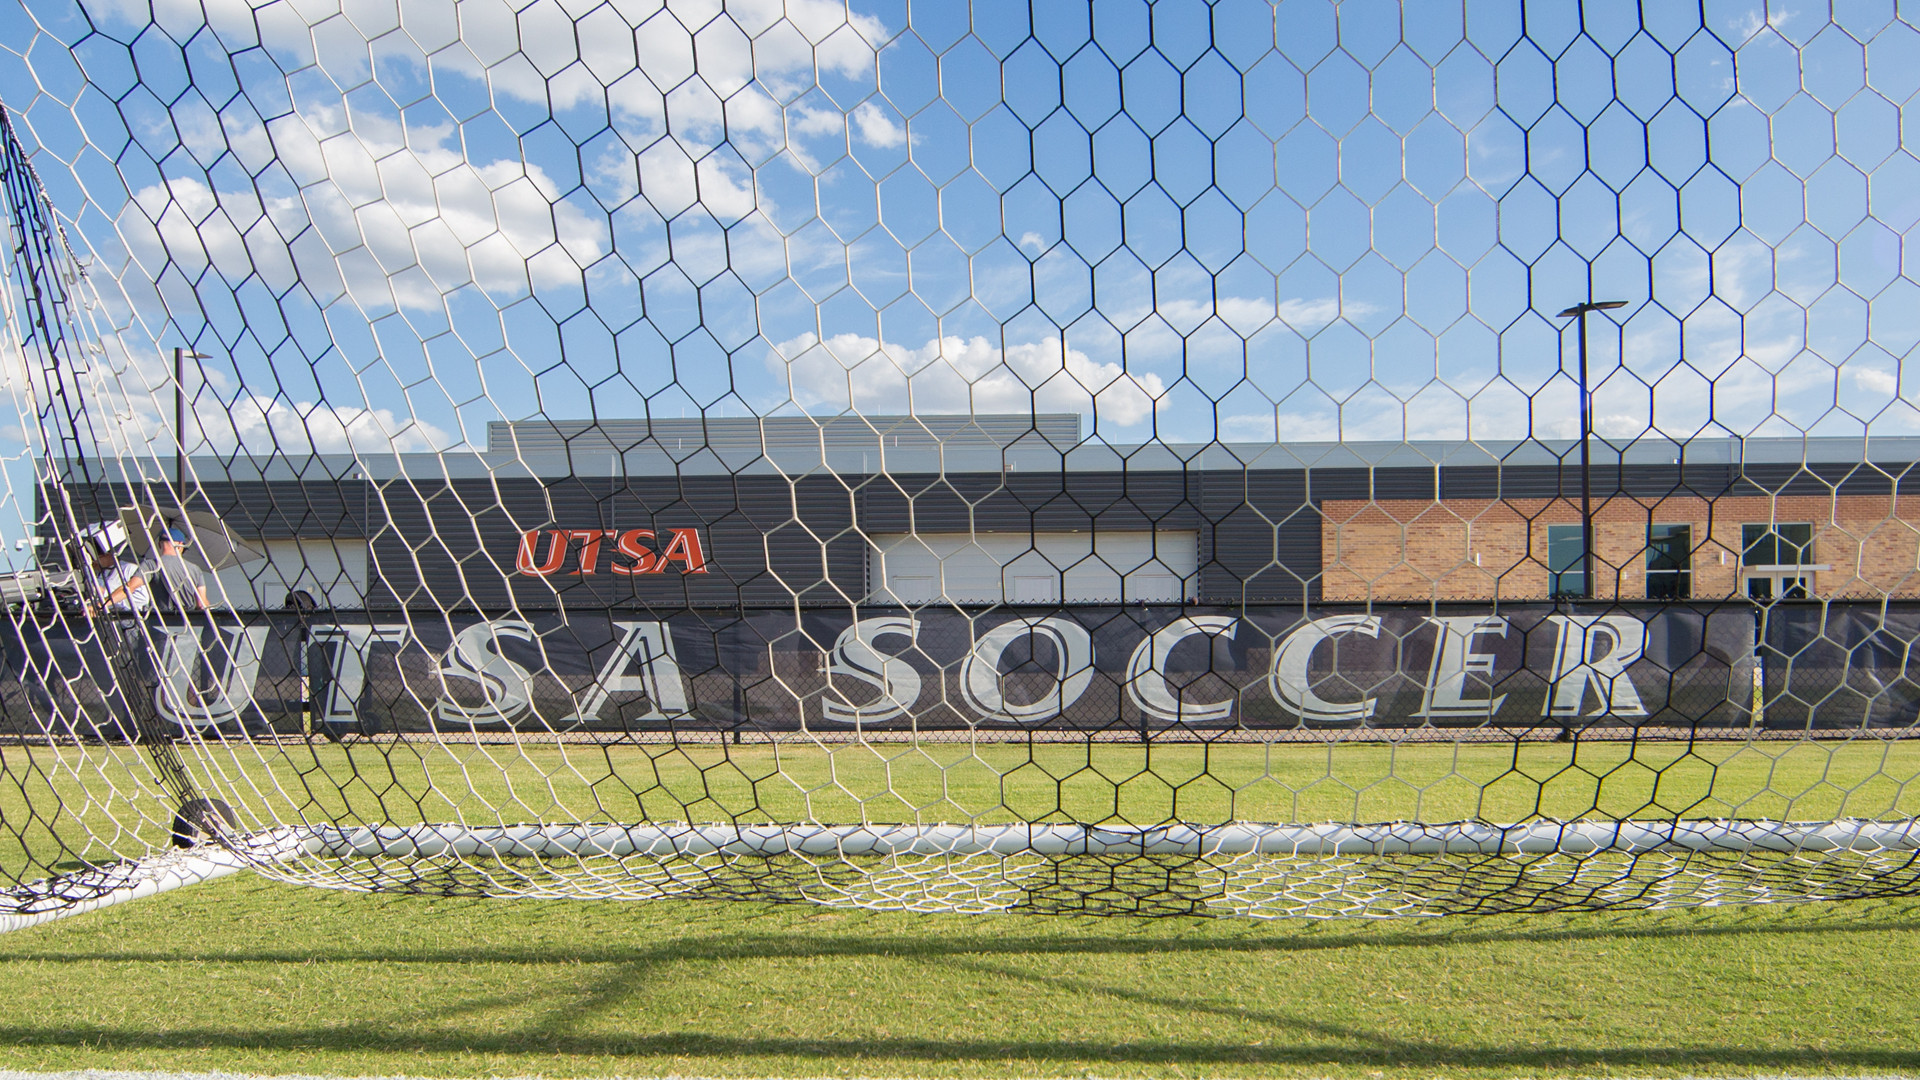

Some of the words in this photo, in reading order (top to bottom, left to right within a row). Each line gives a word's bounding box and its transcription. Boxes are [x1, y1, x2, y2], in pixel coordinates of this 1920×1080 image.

[515, 528, 709, 577] UTSA
[153, 620, 697, 726] UTSA
[818, 616, 1651, 723] SOCCER
